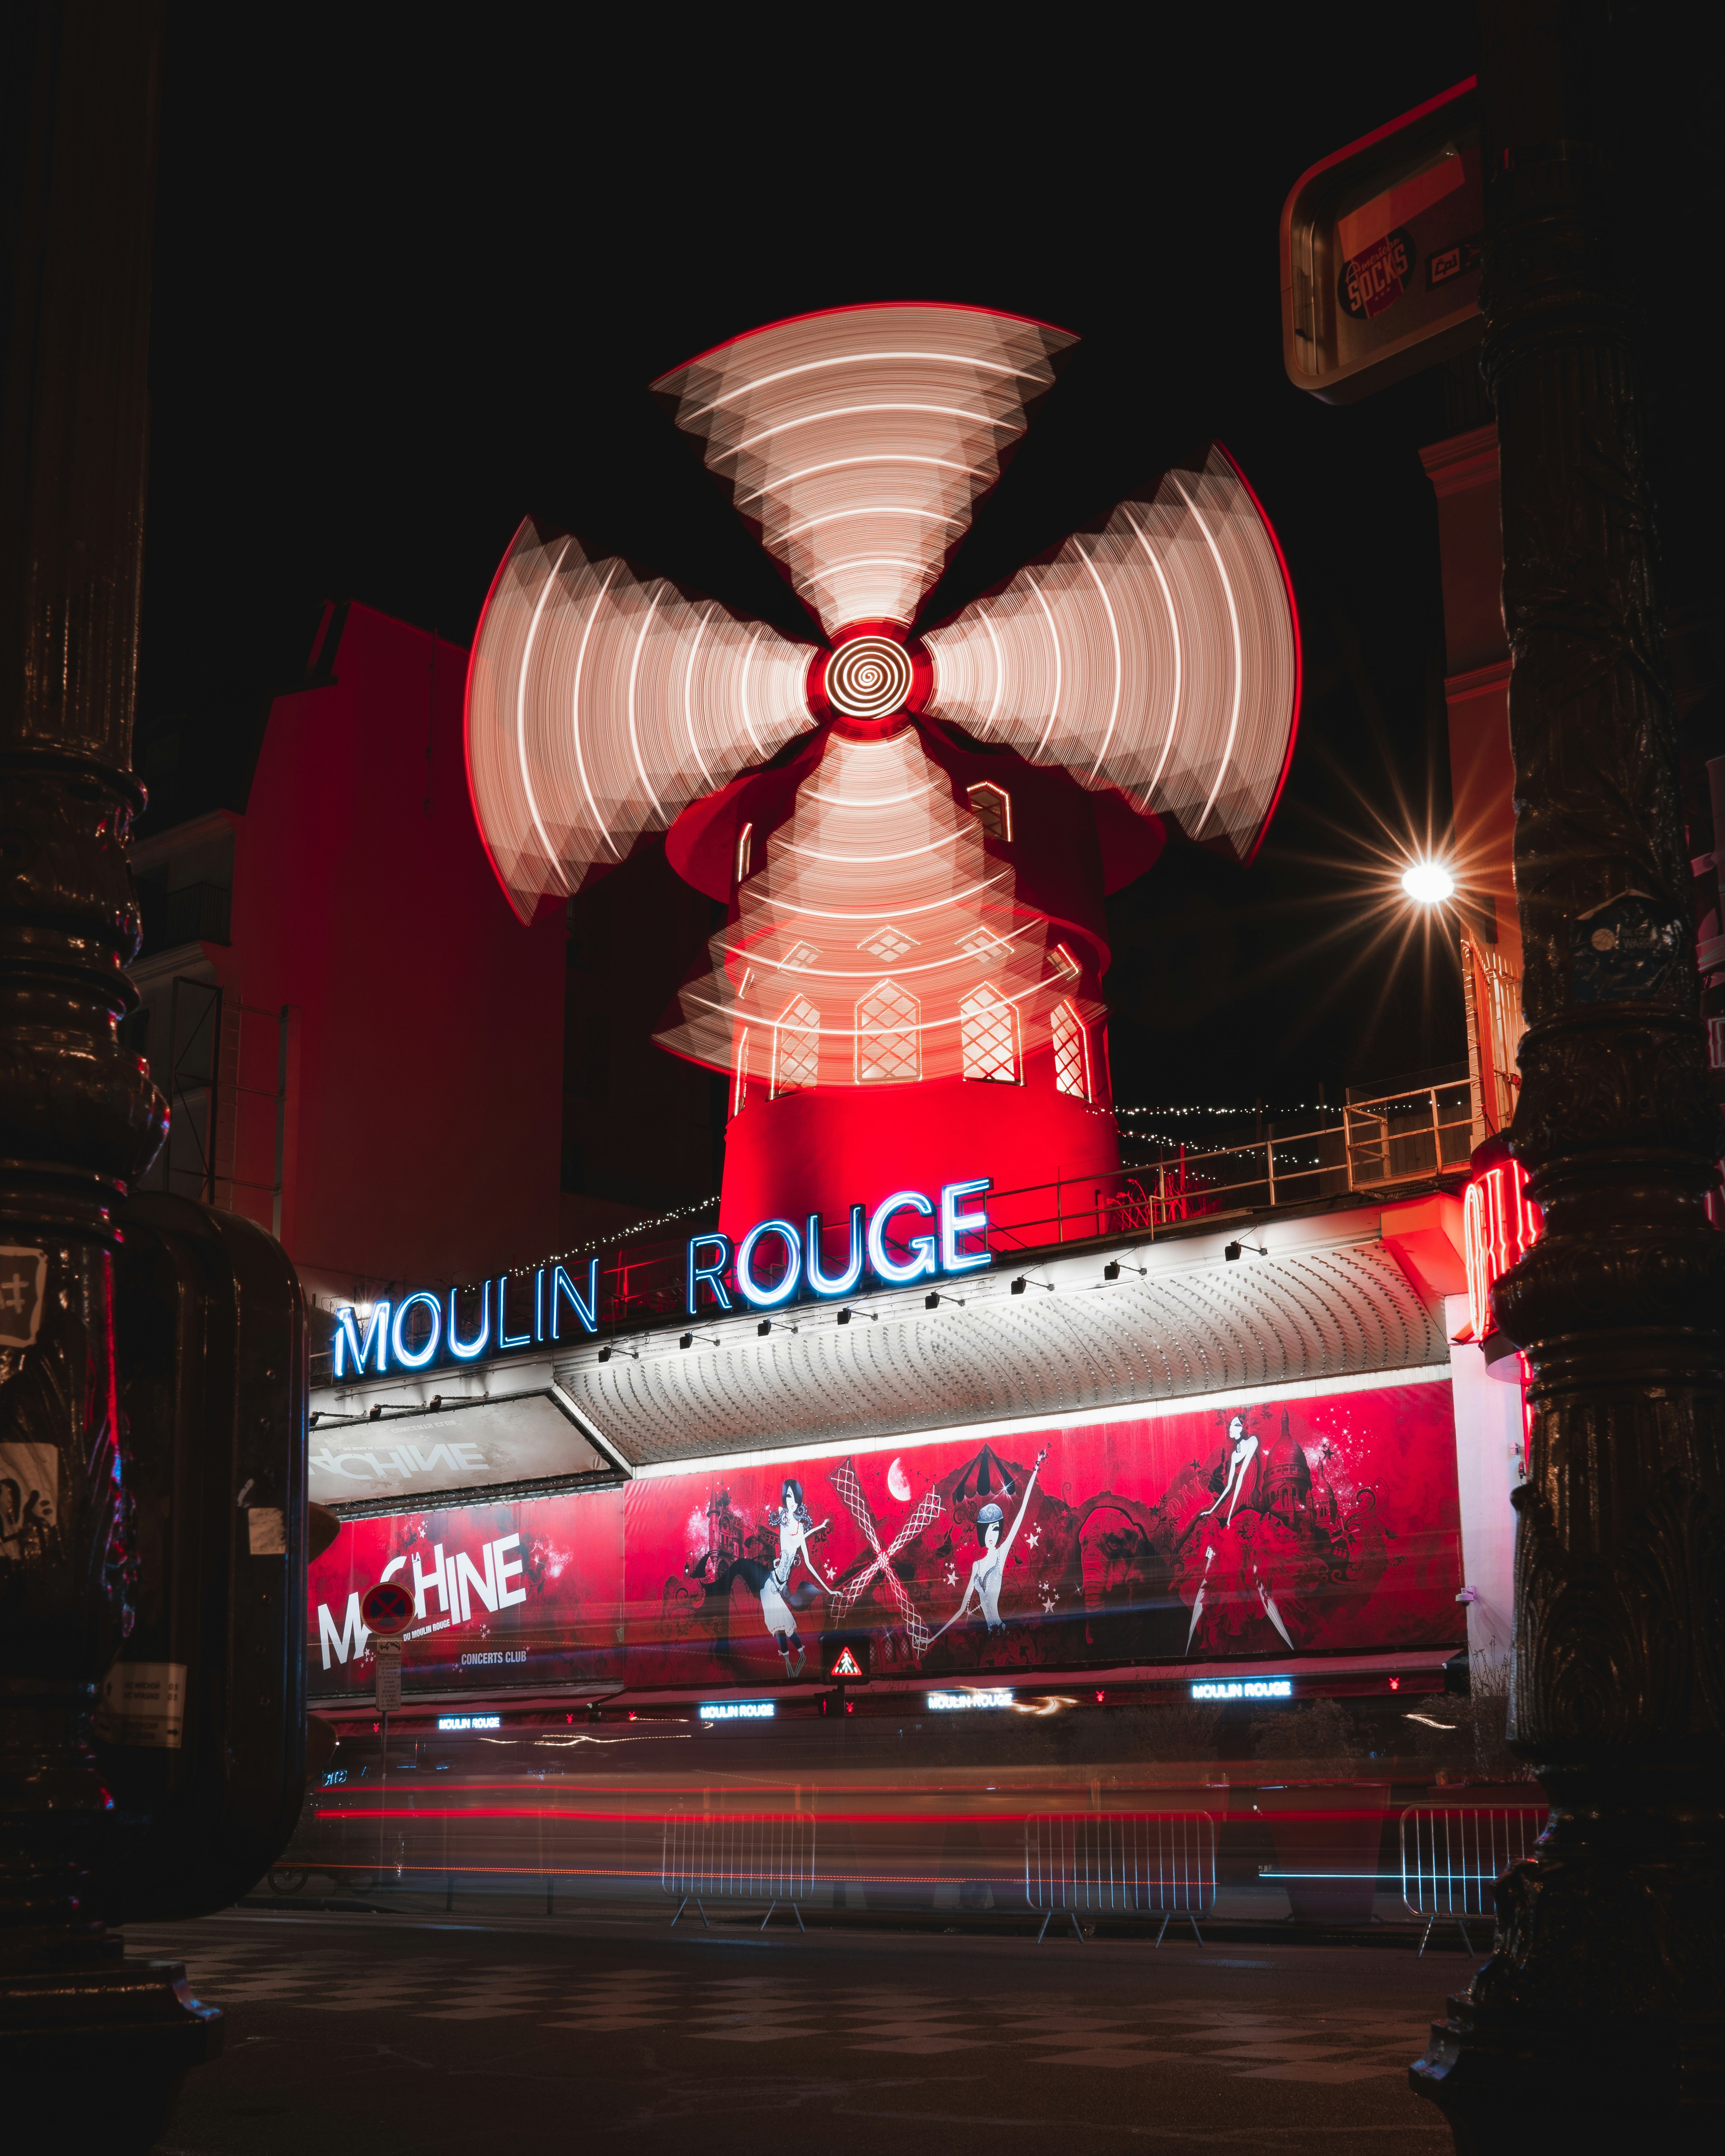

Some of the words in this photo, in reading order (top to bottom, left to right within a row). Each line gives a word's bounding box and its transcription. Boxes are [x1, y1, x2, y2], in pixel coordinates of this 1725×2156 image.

[1345, 236, 1401, 283] American
[1348, 244, 1407, 311] SOCKS
[333, 1257, 599, 1377] MOULIN
[686, 1177, 994, 1314] ROUGE
[411, 1551, 421, 1563] LA
[403, 1632, 411, 1641] DU
[412, 1625, 432, 1639] MOULIN
[432, 1618, 450, 1632] ROUGE
[461, 1652, 503, 1665] CONCERTS
[505, 1651, 526, 1663] CLUB
[1193, 1684, 1242, 1698] MOULIN
[1244, 1682, 1291, 1696] ROUGE
[928, 1695, 971, 1708] MOULIN
[973, 1694, 1012, 1707] ROUGE
[701, 1706, 738, 1718] MOULIN
[739, 1704, 774, 1717] ROUGE
[439, 1719, 470, 1729] MOULIN
[472, 1717, 500, 1728] ROUGE
